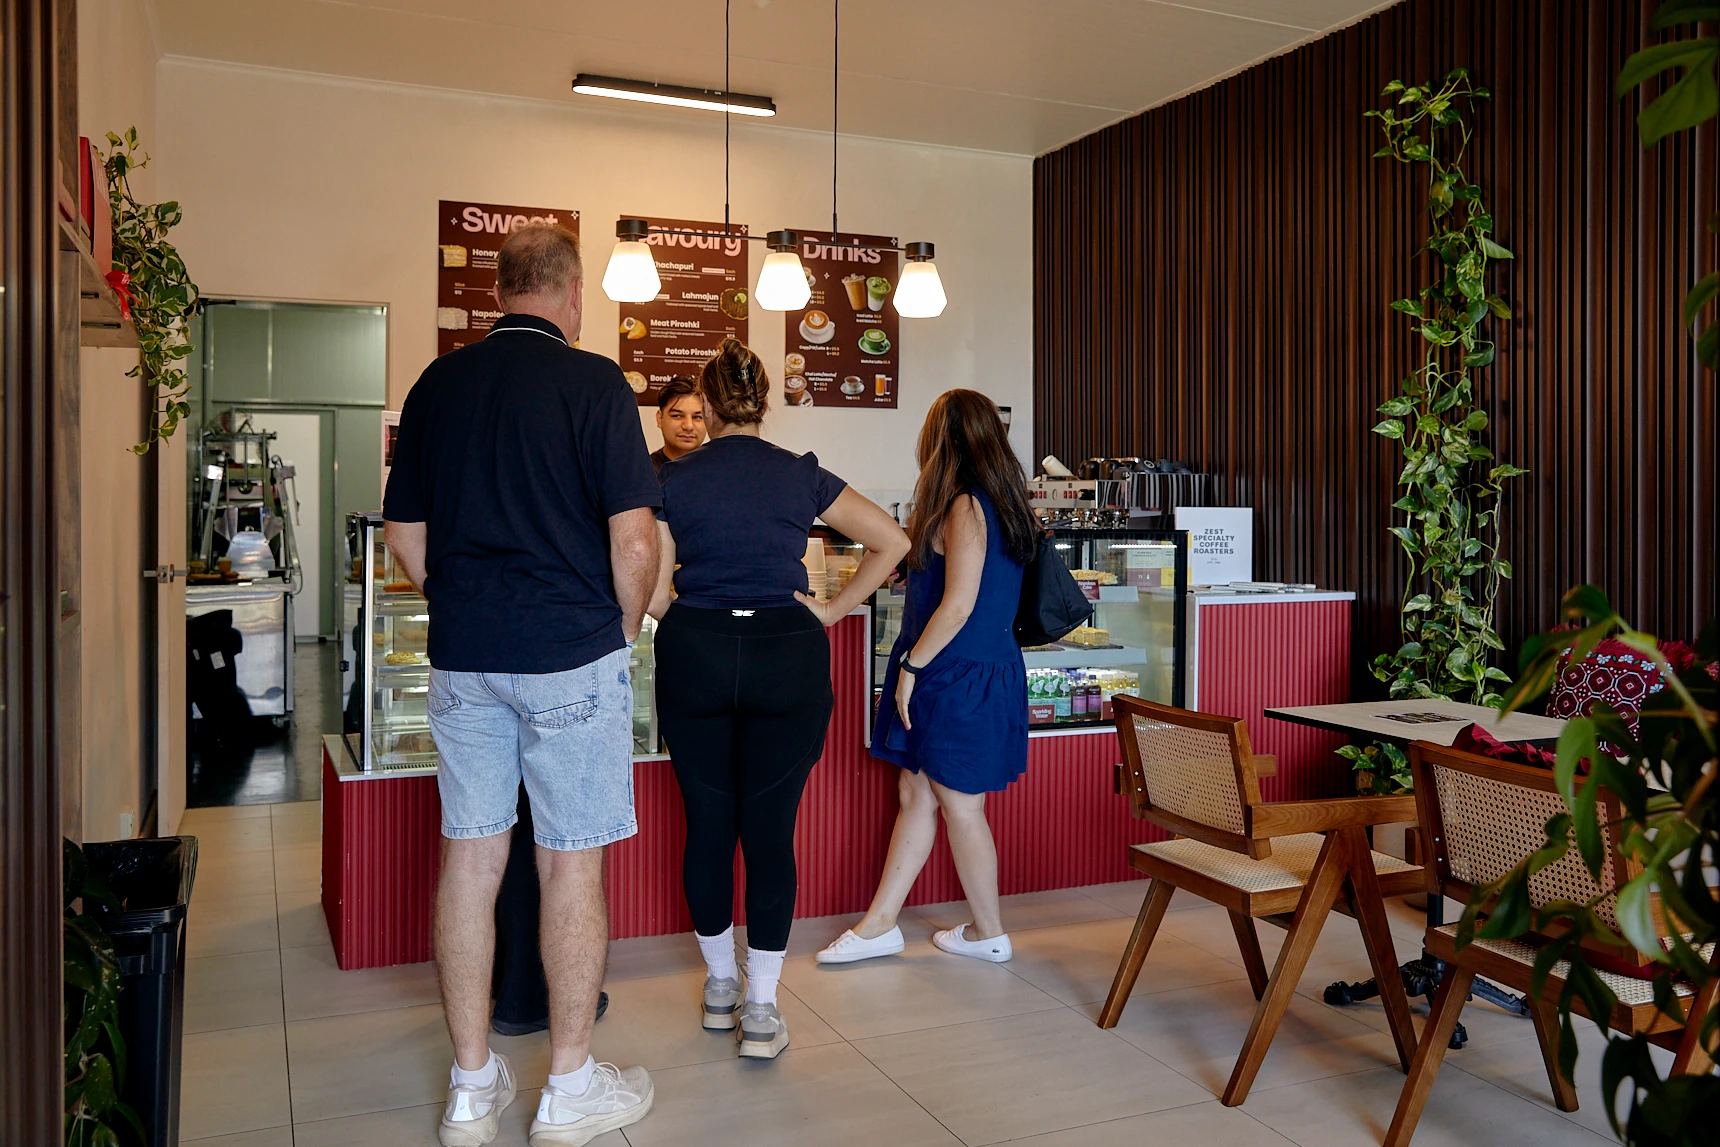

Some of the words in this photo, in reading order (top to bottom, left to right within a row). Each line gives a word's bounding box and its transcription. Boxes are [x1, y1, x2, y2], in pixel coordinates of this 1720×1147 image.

[638, 226, 741, 257] avoury
[473, 248, 498, 259] Honey
[803, 236, 882, 264] Drinks
[682, 291, 719, 302] Lahmajun
[650, 319, 669, 327] Meat
[670, 320, 700, 329] Piroshki
[665, 348, 690, 356] Potato
[650, 374, 671, 383] Borek
